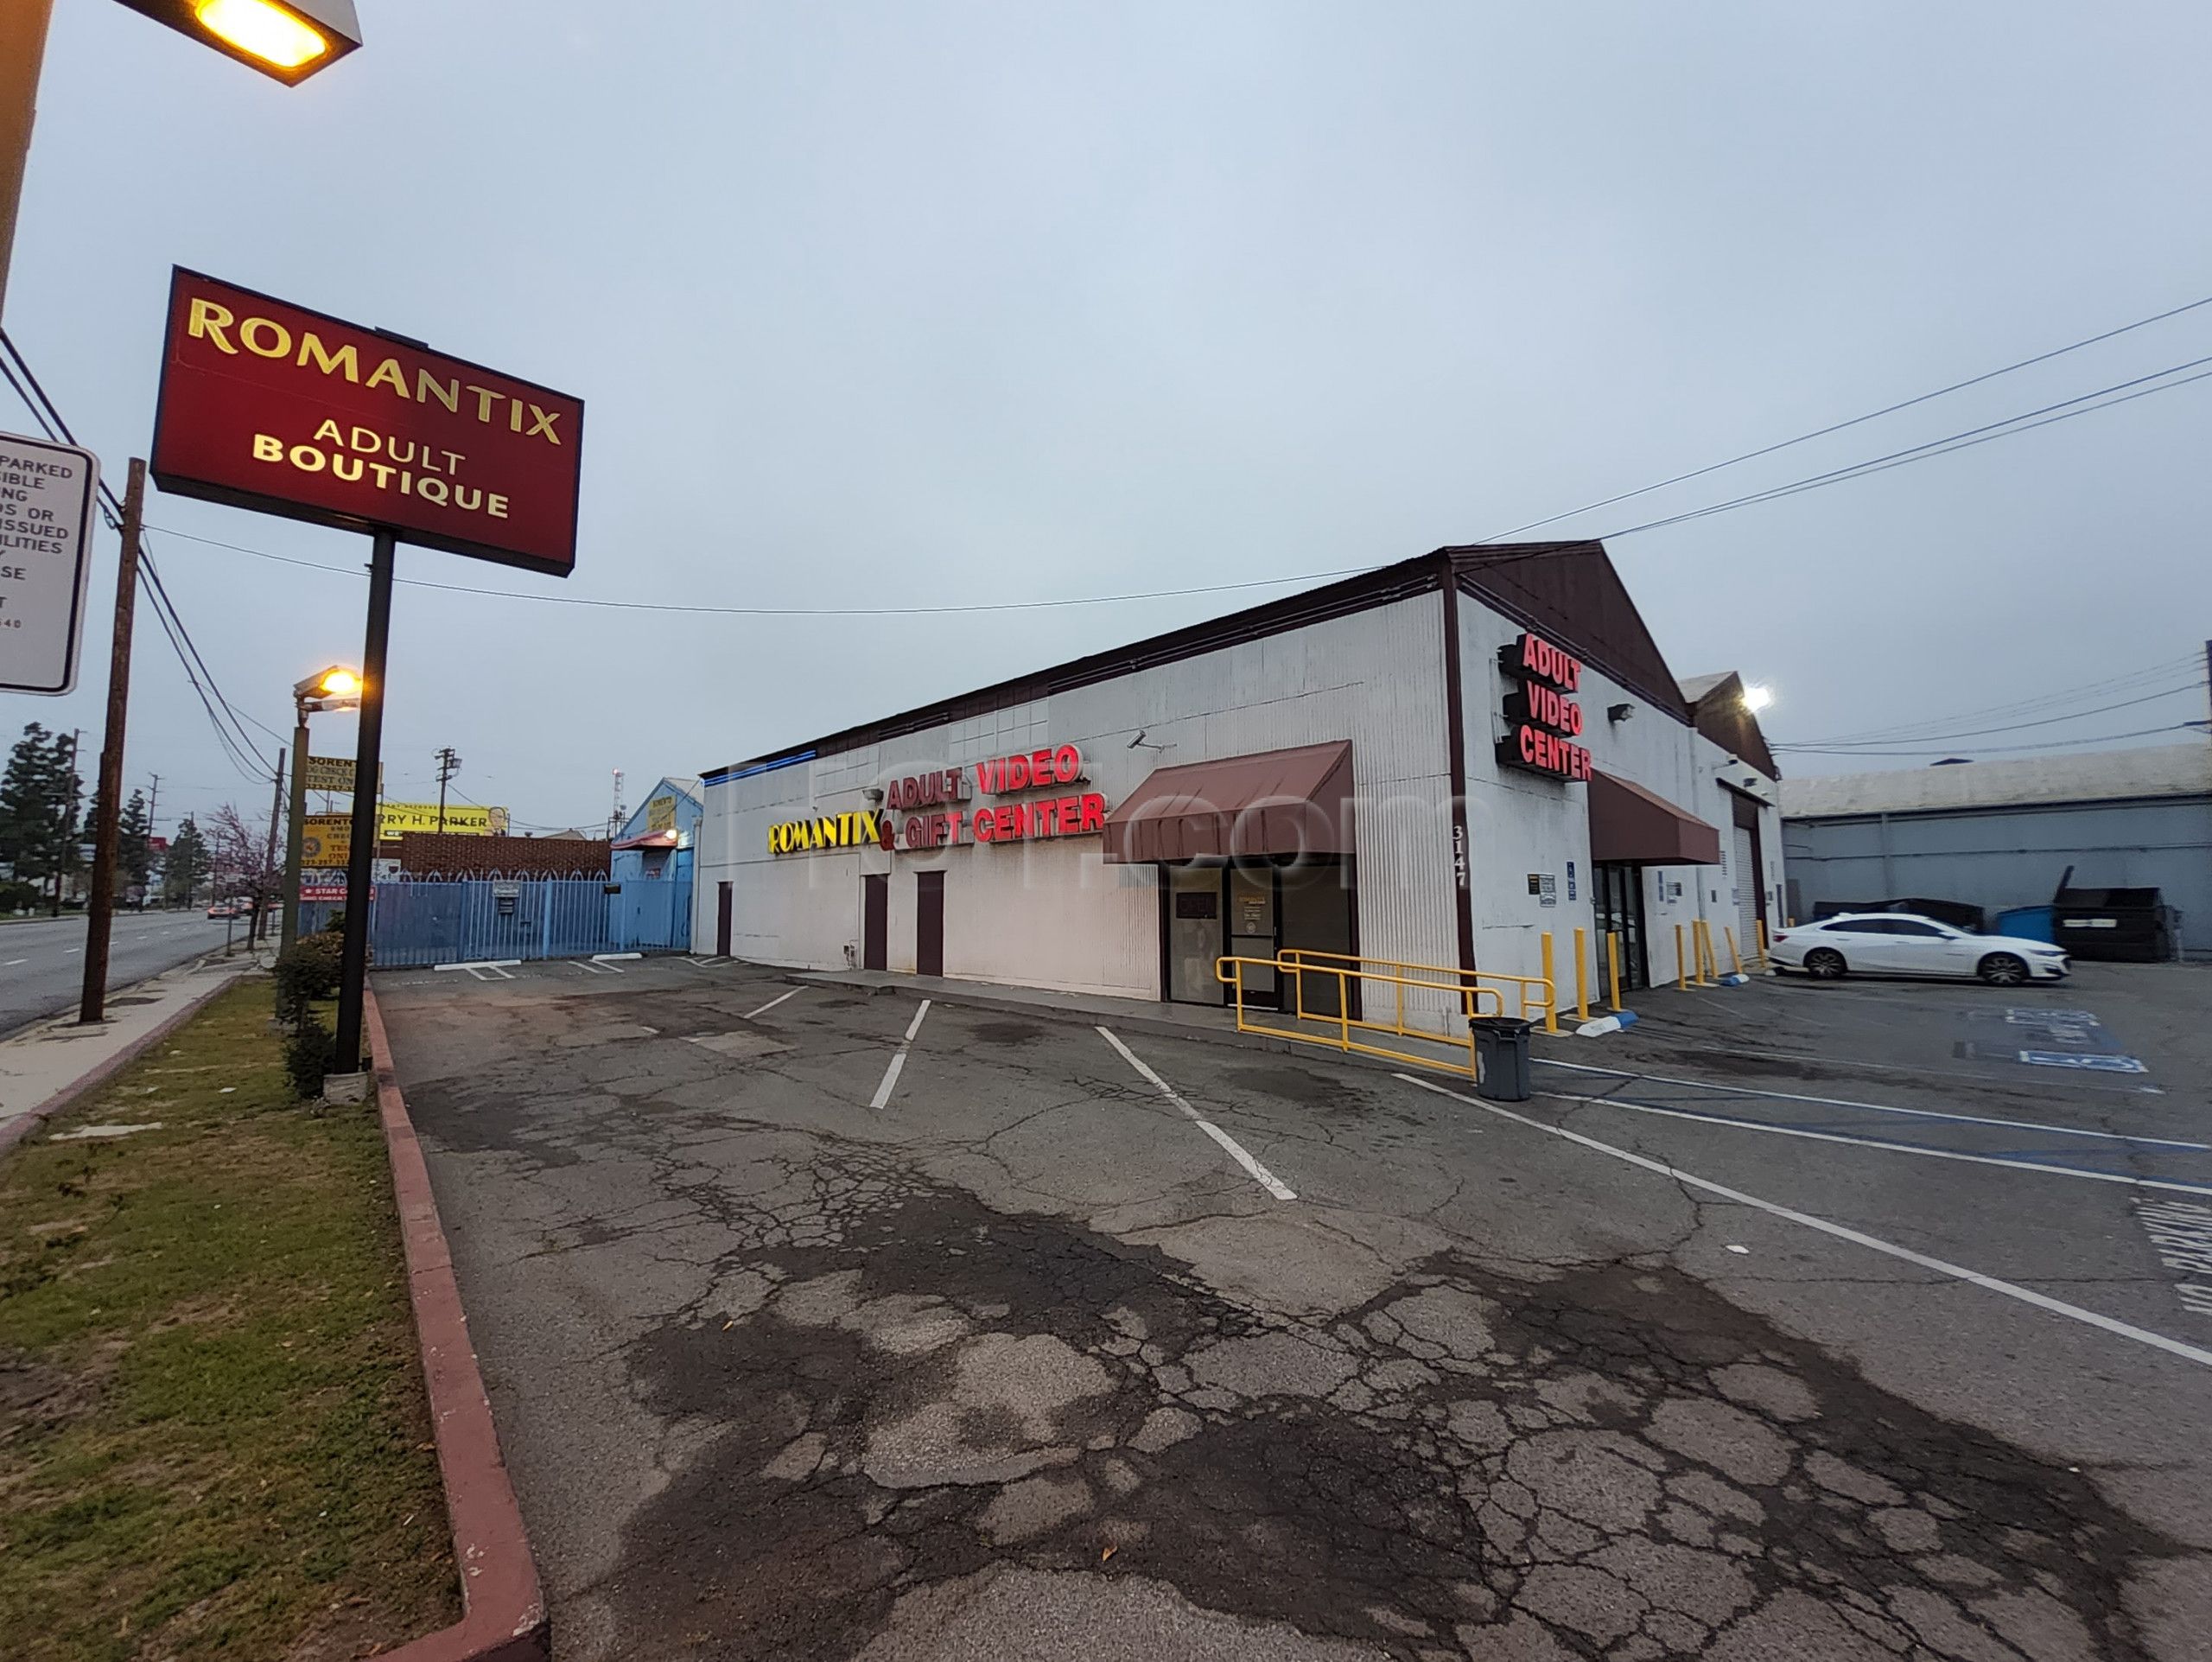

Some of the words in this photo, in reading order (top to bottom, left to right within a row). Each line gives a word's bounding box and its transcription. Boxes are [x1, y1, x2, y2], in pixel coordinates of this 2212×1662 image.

[188, 297, 562, 445] ROMANTIX
[0, 455, 73, 479] PARKED
[313, 419, 466, 475] ADULT
[0, 472, 45, 490] IBLE
[252, 433, 509, 519] BOUTIQUE
[29, 507, 54, 522] OR
[1523, 633, 1581, 691] ADULT
[1527, 680, 1583, 735] VIDEO
[308, 757, 356, 767] SOREN
[887, 767, 964, 812] ADULT
[976, 743, 1082, 795] VIDEO
[1521, 724, 1592, 781] CENTER
[429, 815, 487, 827] PARKER
[768, 808, 882, 854] ROMANTIX
[905, 812, 964, 849] GIFT
[973, 793, 1106, 843] CENTER
[1452, 825, 1466, 887] 3147
